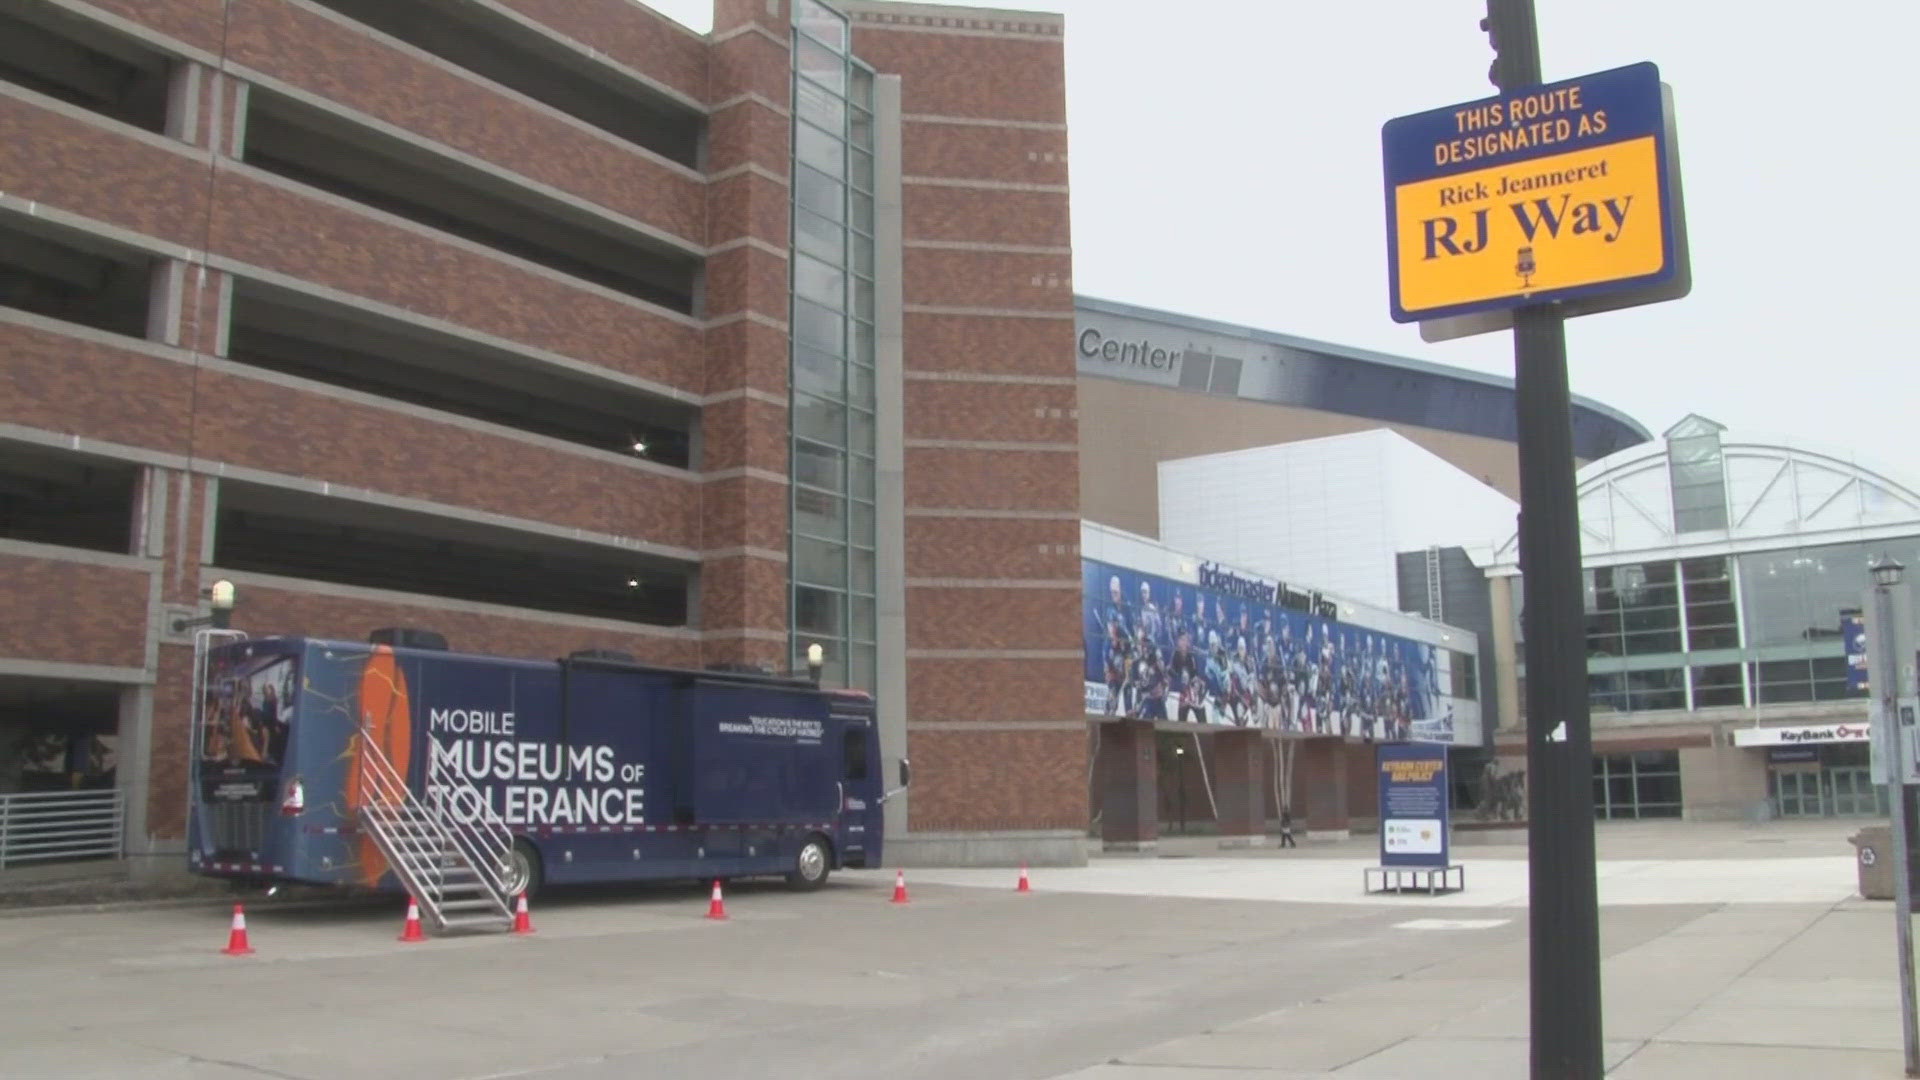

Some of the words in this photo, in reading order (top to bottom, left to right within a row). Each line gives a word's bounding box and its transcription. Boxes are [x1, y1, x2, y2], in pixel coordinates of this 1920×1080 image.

[1455, 104, 1503, 134] THIS
[1509, 86, 1583, 122] ROUTE
[1434, 119, 1571, 167] DESIGNATED
[1577, 111, 1608, 138] AS
[1438, 181, 1490, 209] Rick
[1496, 159, 1609, 197] Jeanneret
[1420, 207, 1492, 262] RJ
[1509, 193, 1634, 244] Way
[1078, 328, 1181, 371] Center
[1199, 560, 1275, 604] ticketmaster
[429, 707, 516, 736] MOBILE
[1780, 729, 1834, 742] KeyBank
[430, 739, 615, 783] MUSEUMS
[620, 764, 645, 783] OF
[428, 785, 645, 824] TOLERANCE
